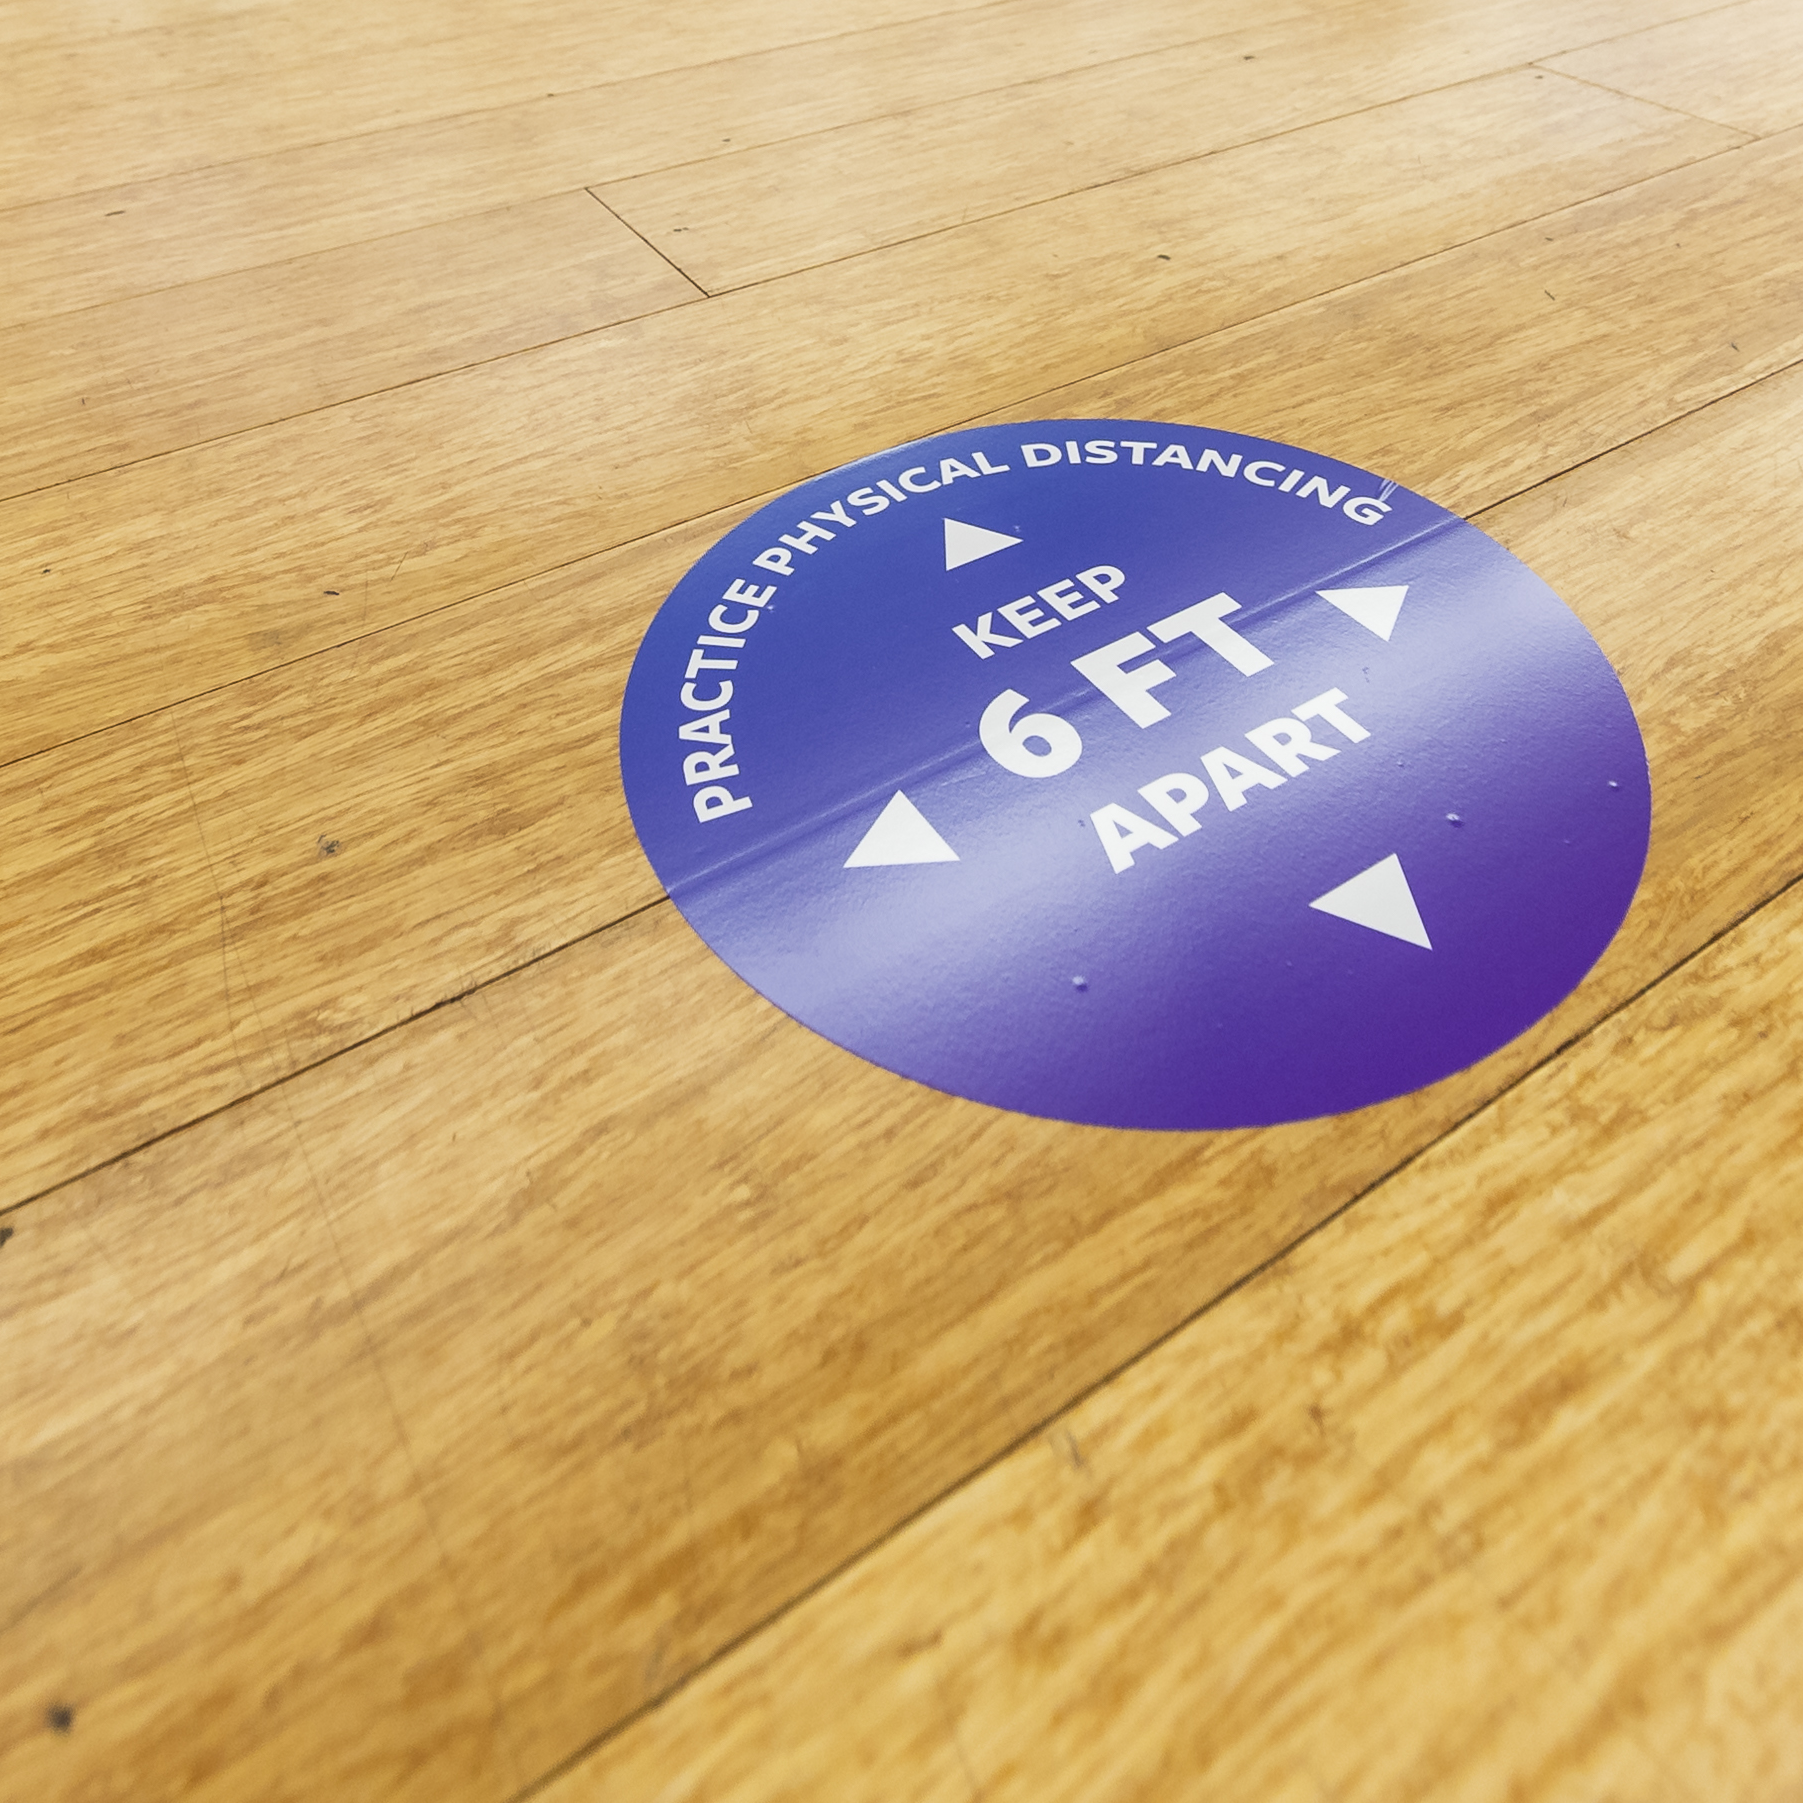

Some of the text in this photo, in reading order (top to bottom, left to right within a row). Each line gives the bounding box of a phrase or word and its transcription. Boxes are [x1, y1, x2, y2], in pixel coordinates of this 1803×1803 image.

[678, 439, 1393, 825] PRACTICE PHYSICAL DISTANCING
[951, 564, 1127, 661] KEEP
[978, 591, 1276, 780] 6 FT
[1088, 686, 1373, 876] APART
